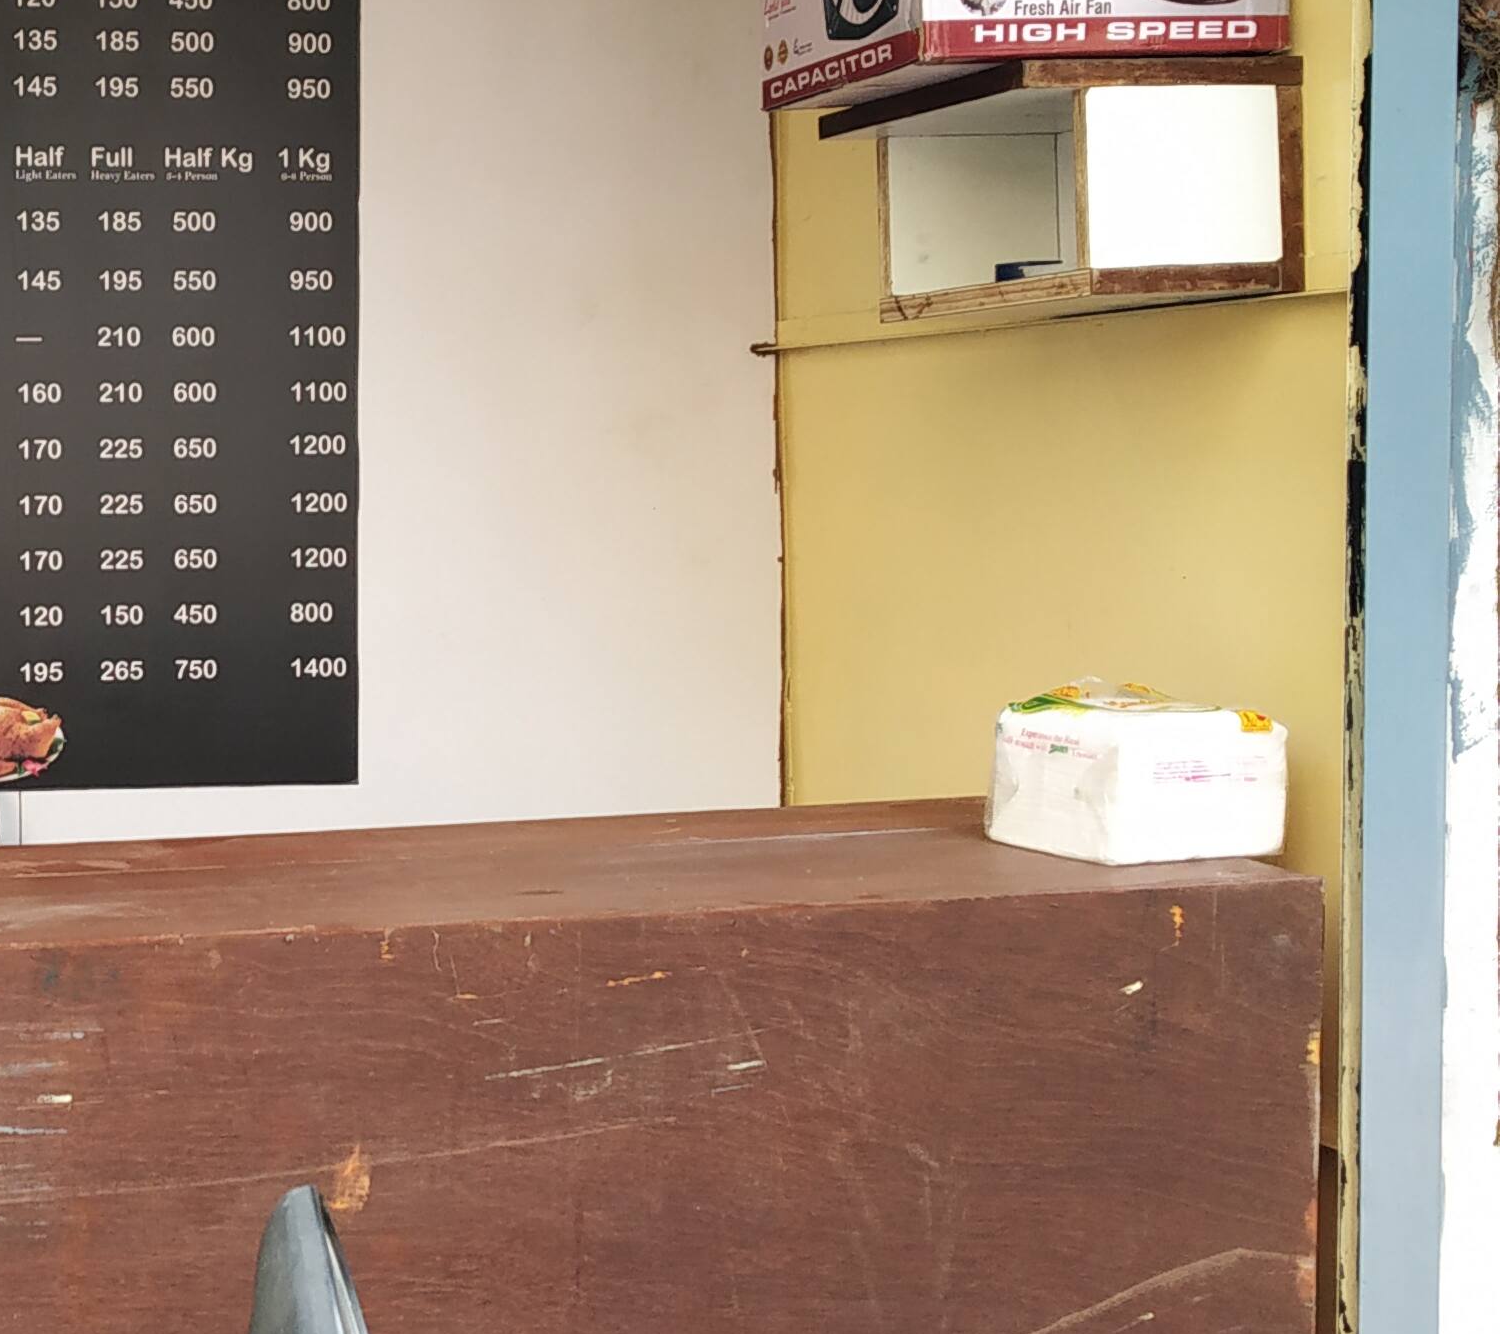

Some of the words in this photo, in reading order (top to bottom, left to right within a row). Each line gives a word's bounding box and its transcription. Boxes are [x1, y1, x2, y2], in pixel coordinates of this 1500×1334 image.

[1013, 0, 1055, 16] Fresh
[13, 29, 58, 51] 135
[96, 30, 140, 52] 185
[170, 31, 214, 53] 500
[973, 21, 1087, 44] HIGH
[1105, 20, 1258, 42] SPEED
[288, 32, 332, 54] 900
[769, 43, 894, 99] CAPACITOR
[13, 75, 57, 97] 145
[95, 76, 139, 98] 195
[170, 77, 214, 99] 550
[287, 78, 331, 100] 950
[15, 145, 65, 167] Half
[91, 146, 133, 168] Full
[164, 147, 213, 168] Half
[221, 147, 253, 173] Kg
[278, 148, 289, 168] 1
[298, 147, 330, 173] Kg
[15, 169, 42, 183] Light
[45, 169, 77, 180] Eaters
[90, 169, 121, 183] Heavy
[123, 170, 156, 181] Eaters
[16, 210, 60, 232] 135
[98, 211, 142, 232] 185
[172, 211, 216, 232] 500
[289, 211, 333, 232] 900
[17, 270, 61, 291] 145
[99, 270, 142, 291] 195
[173, 270, 217, 291] 550
[289, 270, 333, 291] 950
[97, 326, 141, 347] 210
[172, 326, 215, 347] 600
[289, 325, 346, 347] 1100
[18, 382, 62, 404] 160
[99, 382, 143, 403] 210
[173, 382, 217, 403] 600
[290, 381, 347, 402] 1100
[18, 438, 62, 460] 170
[99, 438, 143, 459] 225
[173, 437, 217, 459] 650
[289, 434, 346, 455] 1200
[19, 494, 63, 516] 170
[100, 494, 144, 515] 225
[174, 493, 217, 514] 650
[291, 492, 348, 513] 1200
[19, 550, 63, 571] 170
[100, 549, 144, 570] 225
[174, 548, 217, 570] 650
[291, 547, 347, 568] 1200
[19, 605, 63, 627] 120
[100, 604, 144, 625] 150
[173, 604, 217, 625] 450
[290, 602, 333, 623] 800
[19, 661, 64, 683] 195
[100, 660, 144, 681] 265
[175, 659, 218, 680] 750
[290, 657, 347, 678] 1400
